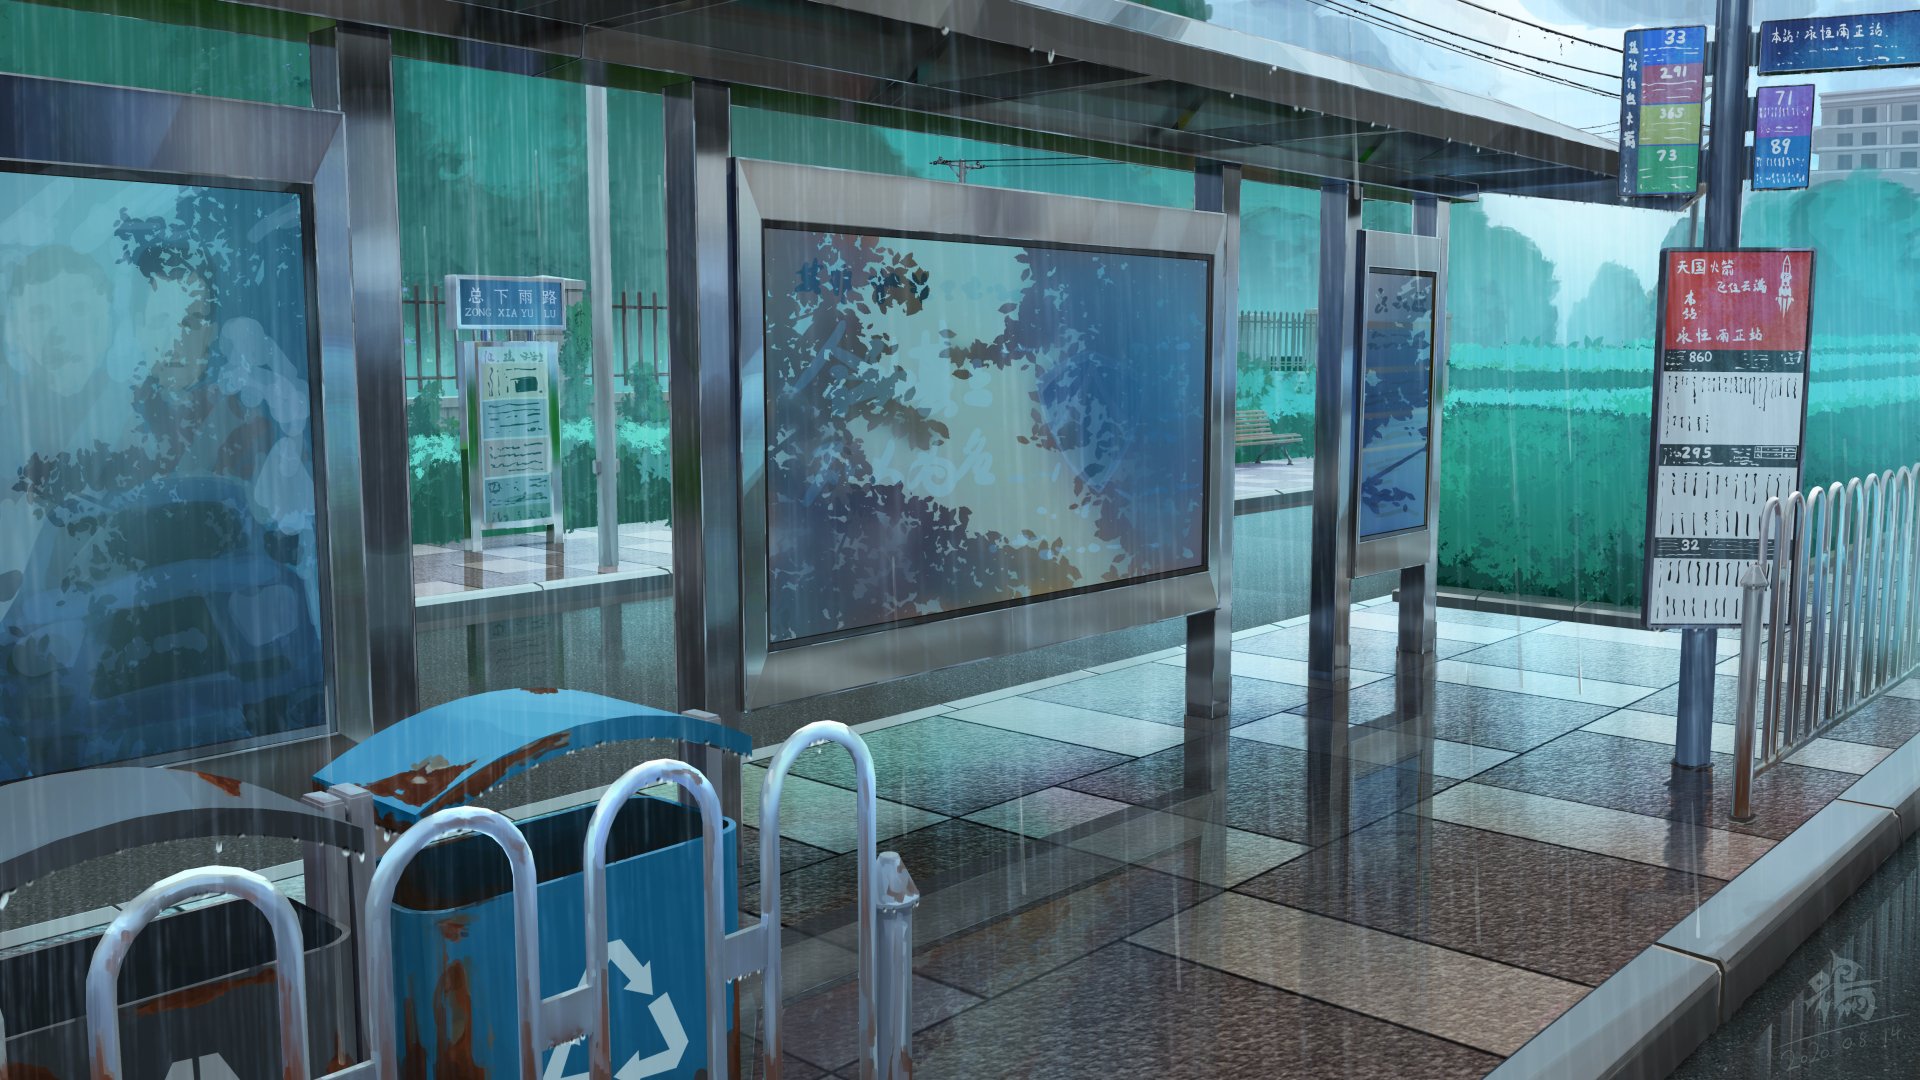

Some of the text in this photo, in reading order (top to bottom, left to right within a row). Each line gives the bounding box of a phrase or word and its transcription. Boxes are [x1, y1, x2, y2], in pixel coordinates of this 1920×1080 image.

[1664, 30, 1686, 45] 33
[1660, 64, 1687, 79] 291
[1776, 90, 1793, 106] 71
[1659, 107, 1684, 119] 365
[1771, 139, 1791, 154] 89
[1657, 149, 1677, 161] 73
[1676, 258, 1734, 276] 天国火箭
[468, 287, 557, 305] 总下雨路
[465, 308, 556, 318] ZONG XIA YU LU
[1689, 351, 1712, 362] 860
[1681, 446, 1712, 459] 295
[1681, 539, 1700, 551] 32
